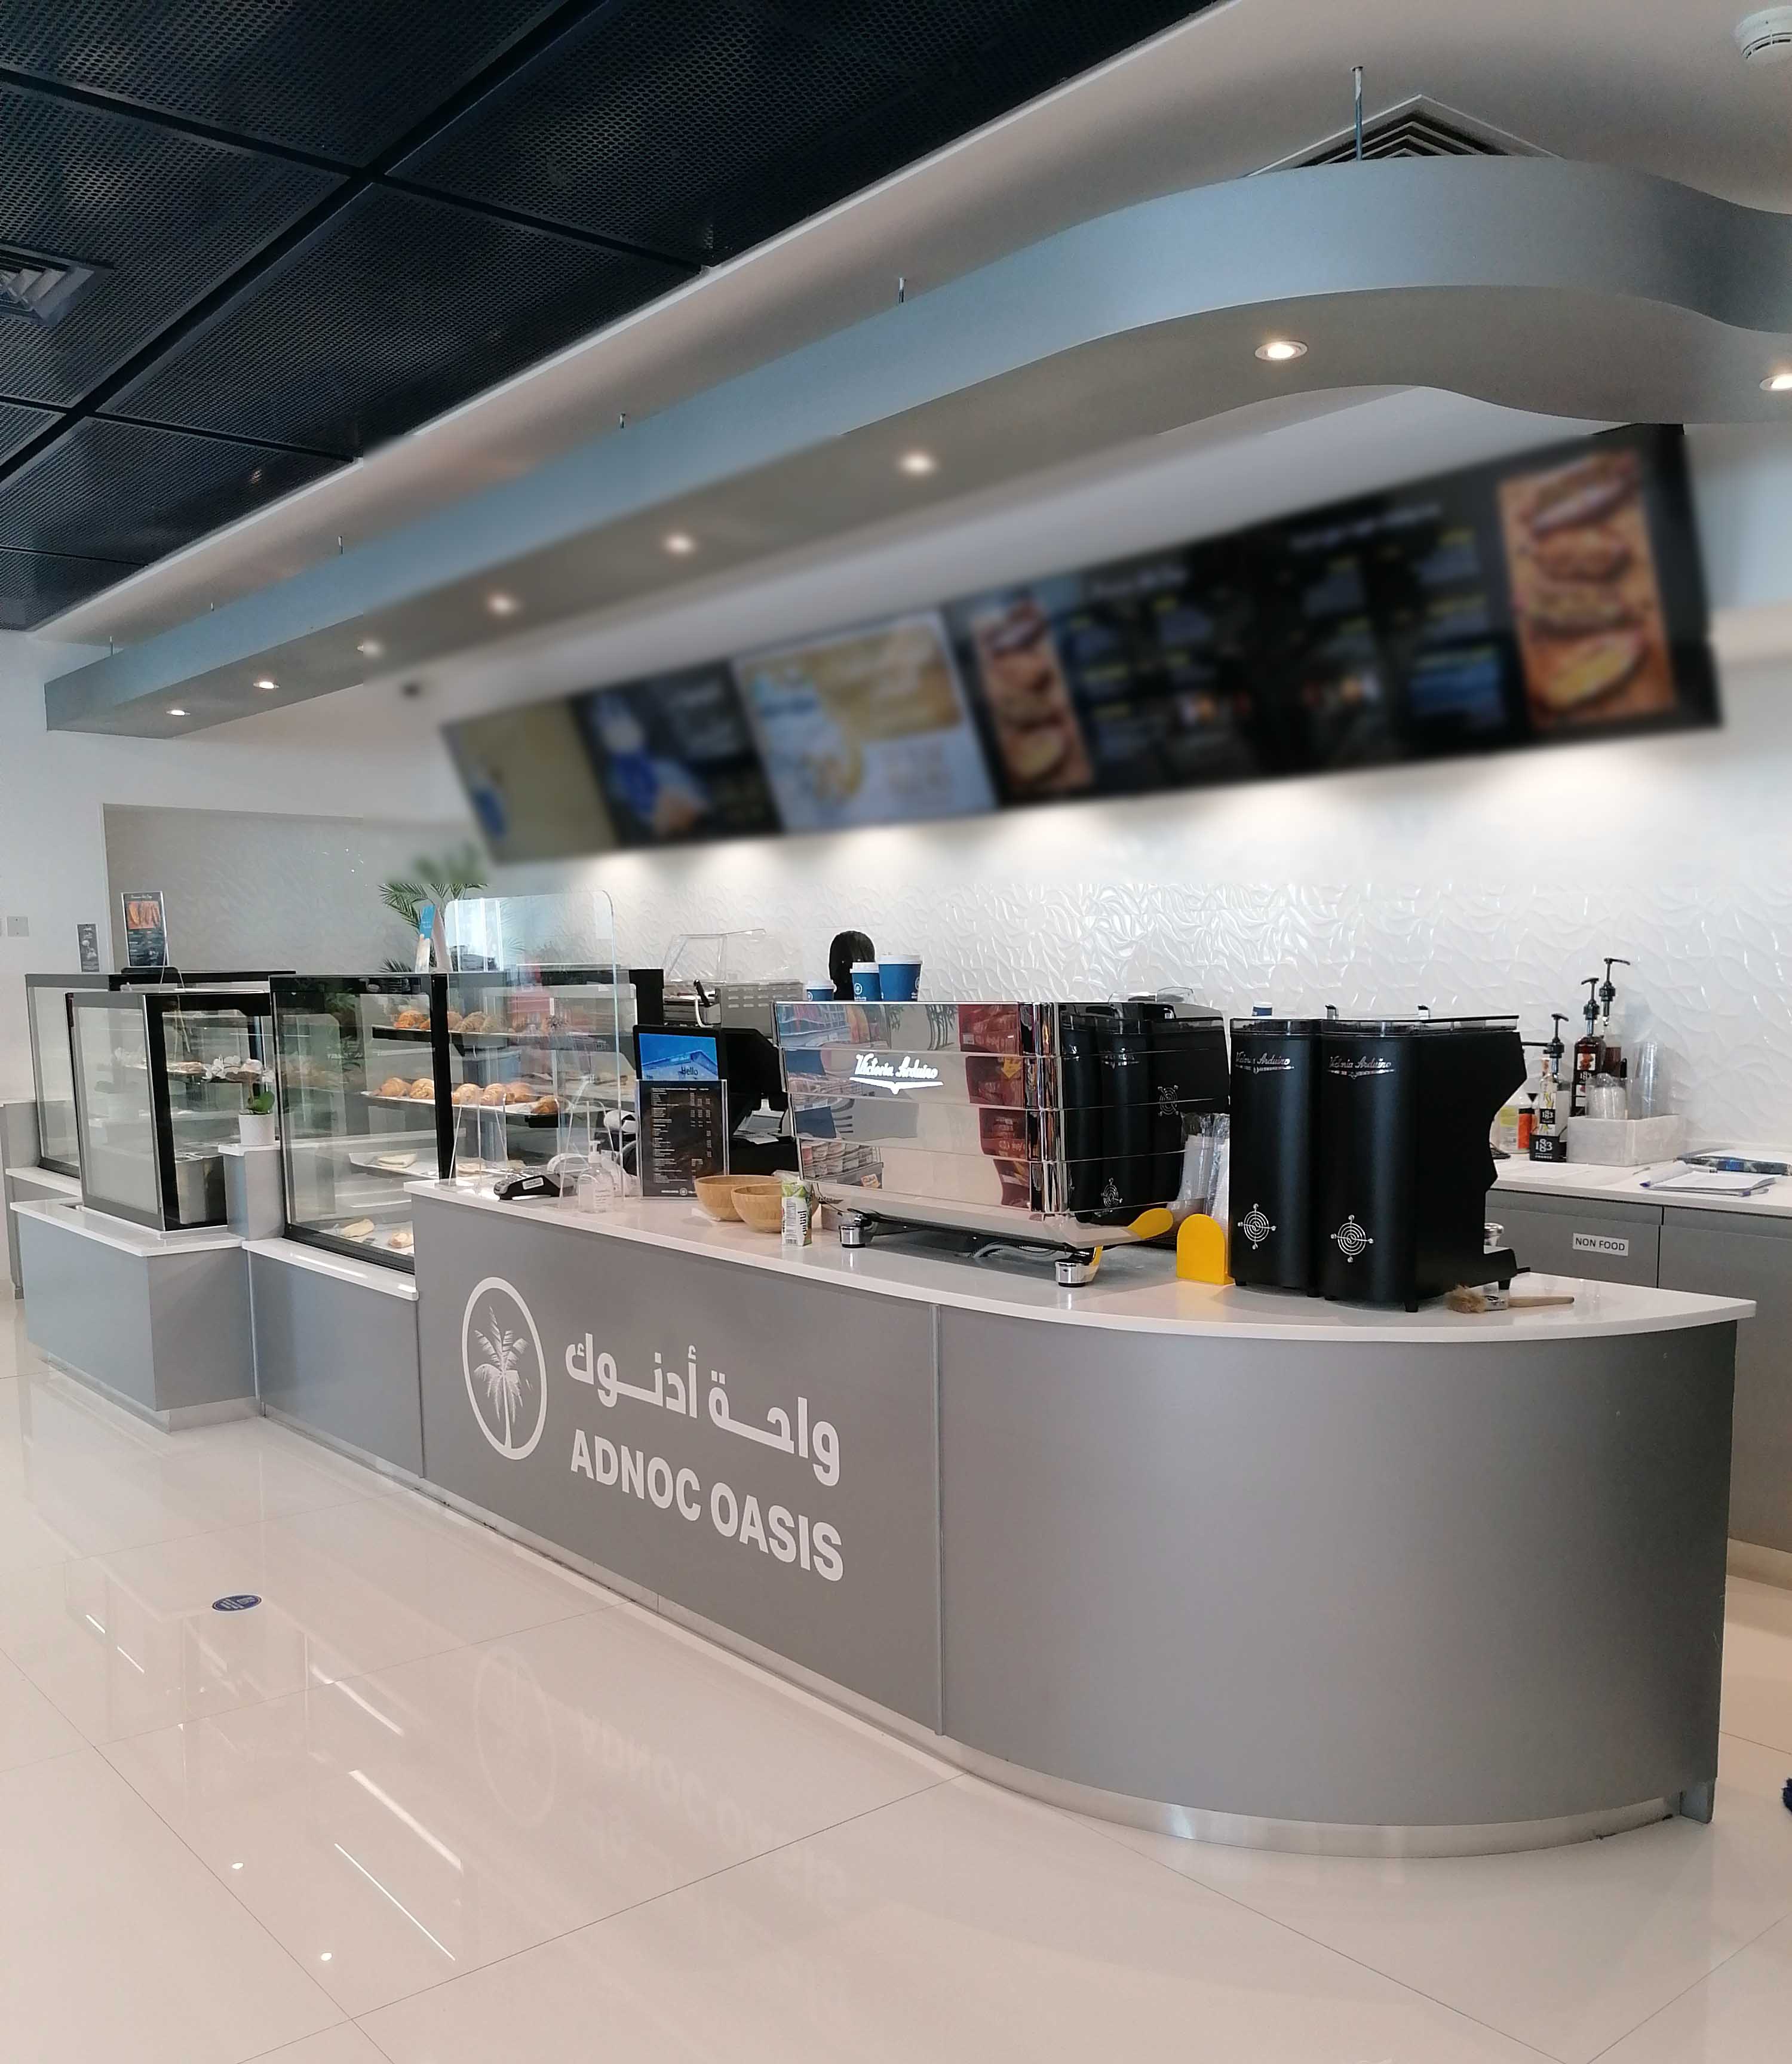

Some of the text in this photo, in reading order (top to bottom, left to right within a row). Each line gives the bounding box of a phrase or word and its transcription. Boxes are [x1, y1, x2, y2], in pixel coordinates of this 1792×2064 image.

[1257, 1052, 1291, 1065] Arduino
[1354, 1056, 1392, 1068] Arduino
[680, 1067, 698, 1076] Hello
[1535, 1138, 1552, 1152] 183
[1575, 1237, 1625, 1251] NON FOOD
[566, 1332, 840, 1486] واحة أدنوك
[570, 1429, 843, 1581] ADNOC OASIS
